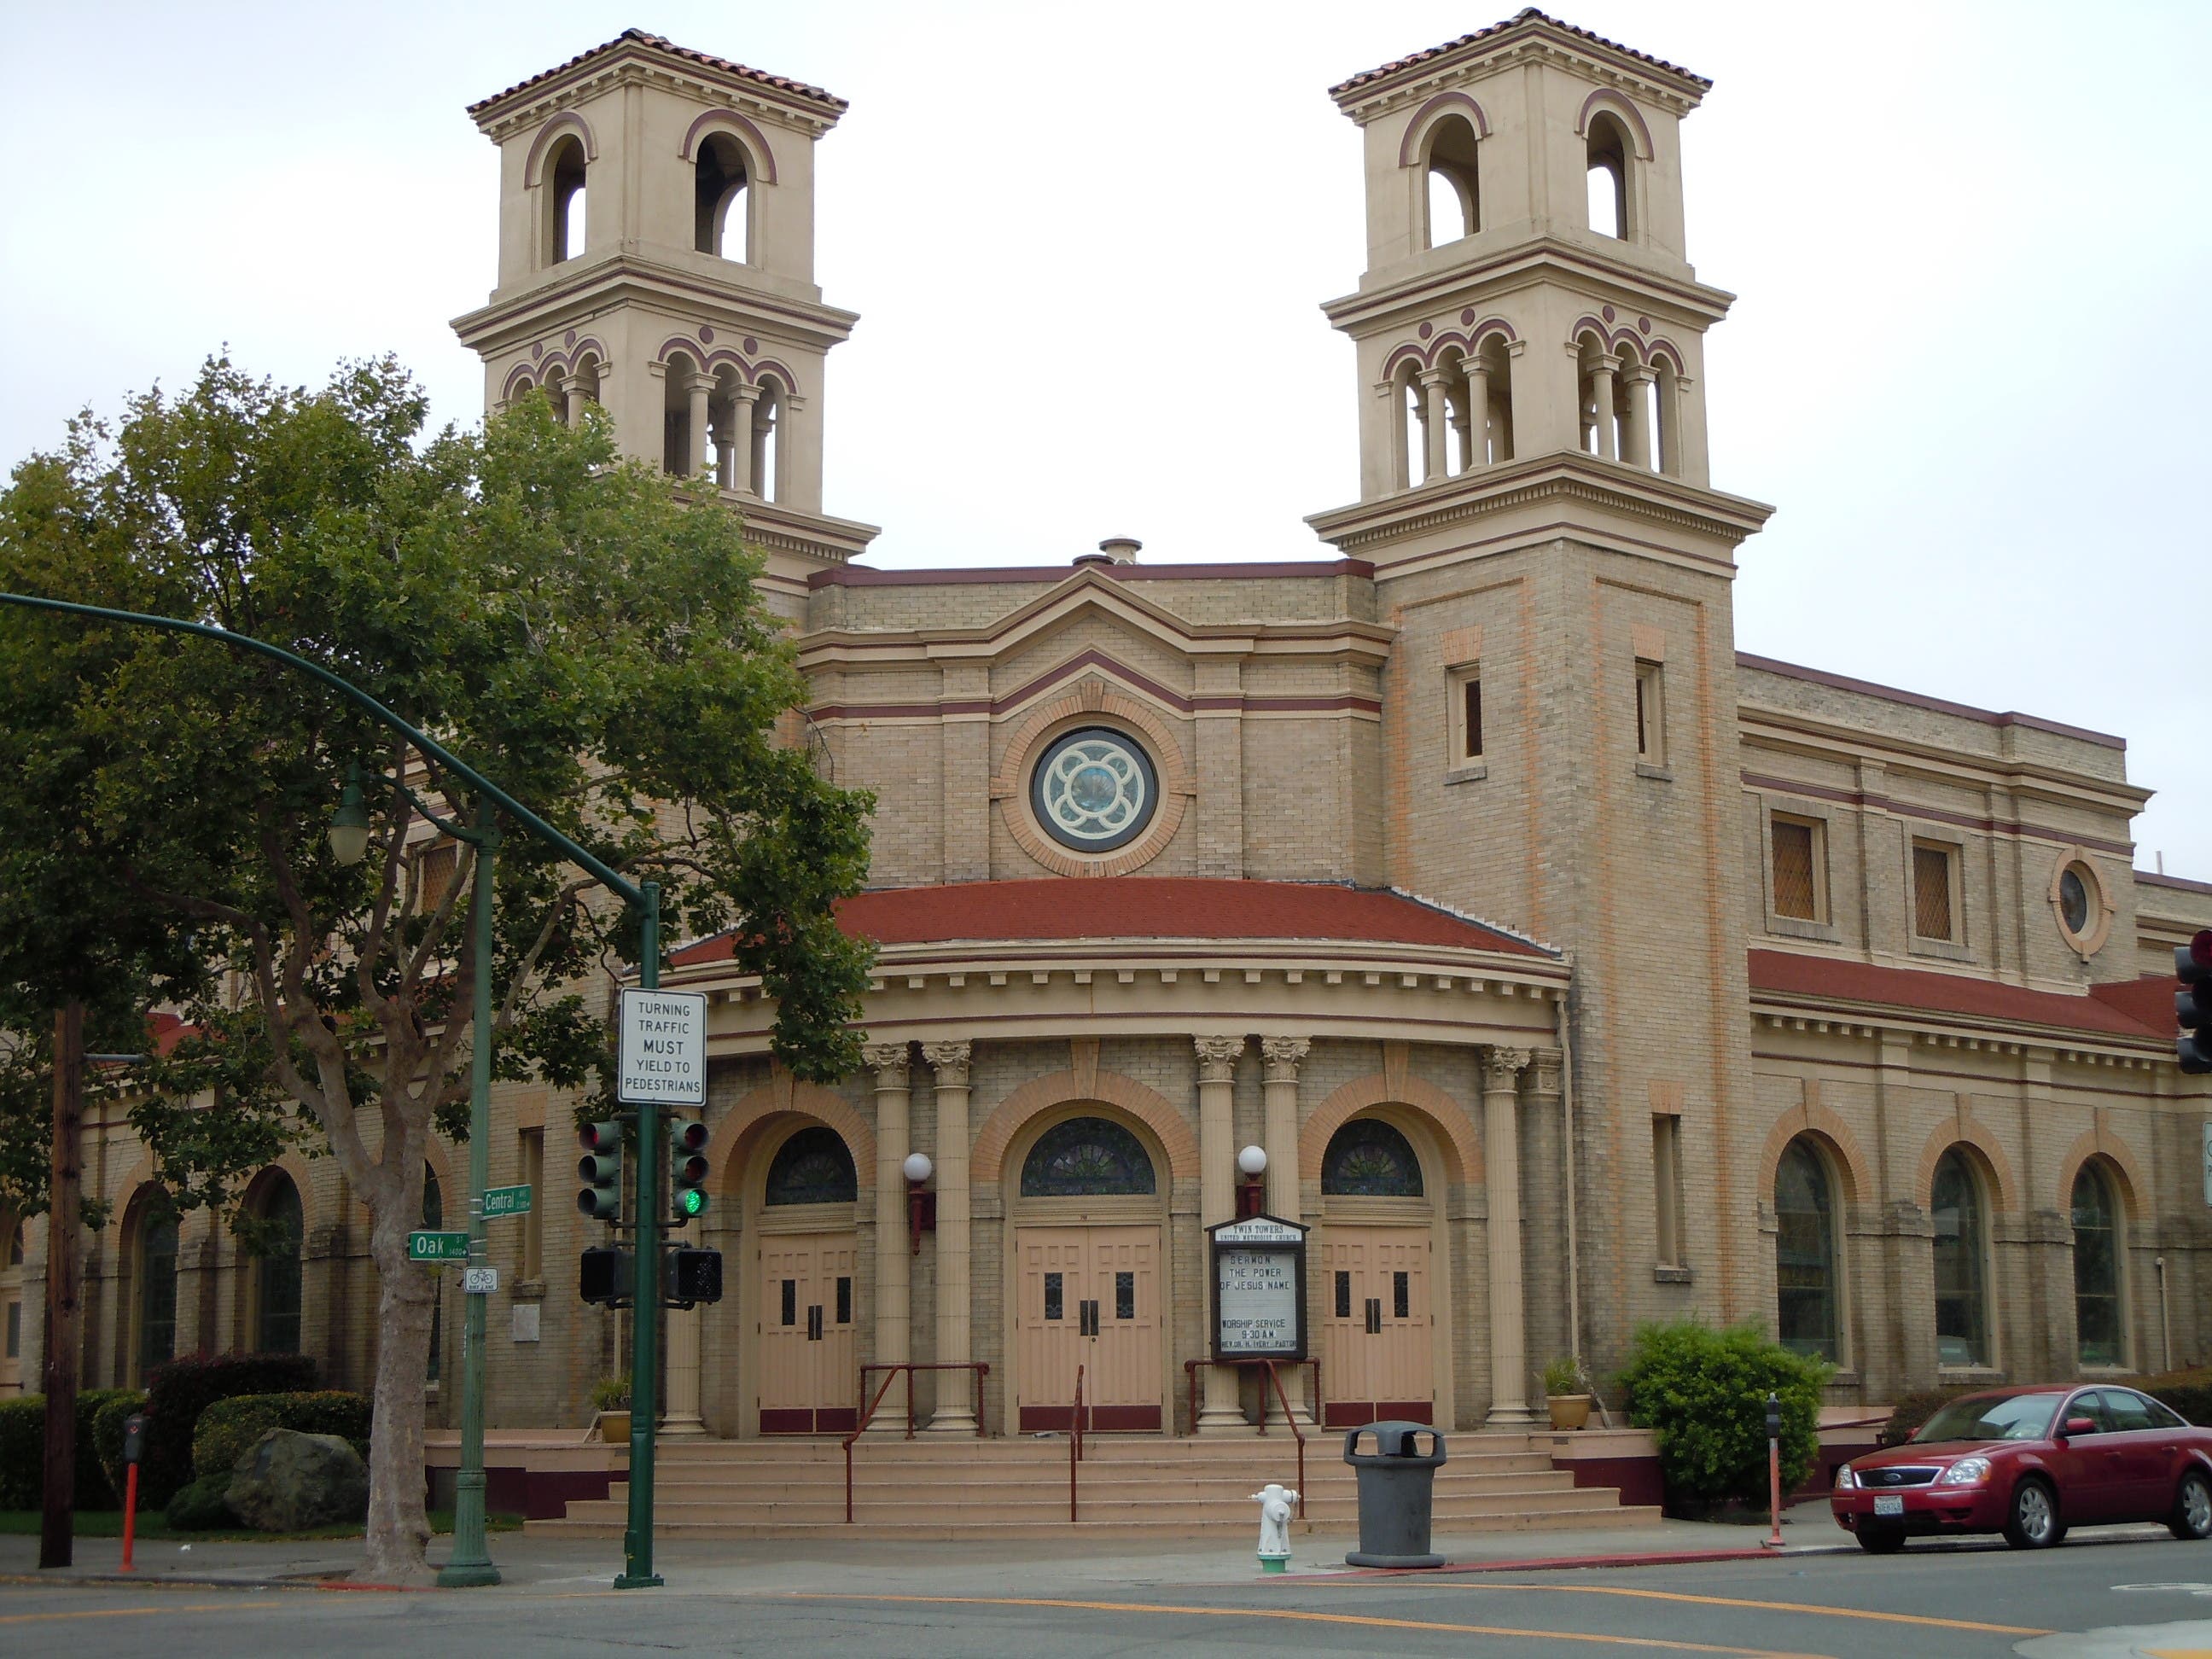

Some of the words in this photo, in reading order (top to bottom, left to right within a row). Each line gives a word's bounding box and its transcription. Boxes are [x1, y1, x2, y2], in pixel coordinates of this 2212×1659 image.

[638, 1002, 690, 1016] TURNING
[638, 1020, 690, 1033] TRAFFIC
[643, 1039, 684, 1055] MUST
[636, 1059, 672, 1073] YIELD
[675, 1062, 690, 1074] TO
[625, 1077, 701, 1092] PEDESTRIANS
[486, 1192, 515, 1210] Central
[1233, 1225, 1252, 1234] TWIN
[1254, 1225, 1284, 1234] TOWERS
[416, 1237, 444, 1254] Oak
[1230, 1268, 1246, 1277] THE
[1253, 1268, 1282, 1277] POWER
[1220, 1281, 1231, 1290] OF
[1234, 1281, 1263, 1290] JESUS
[1267, 1281, 1289, 1290] NAME
[1222, 1319, 1253, 1329] WORSHIP
[1255, 1319, 1285, 1329] SERVICE
